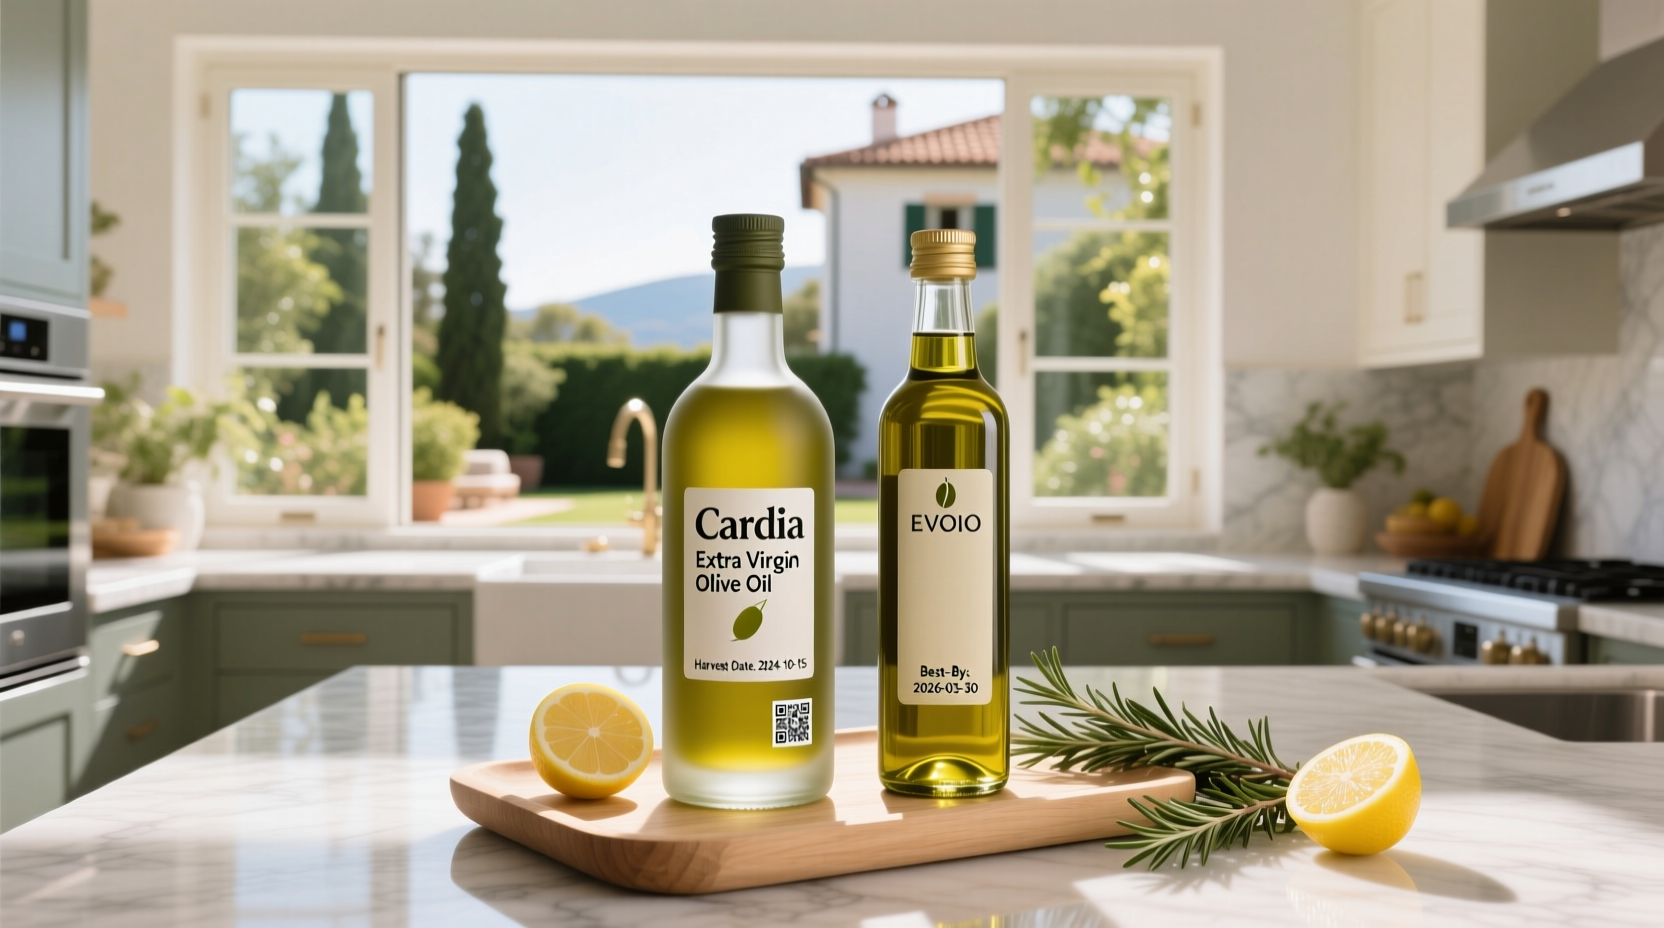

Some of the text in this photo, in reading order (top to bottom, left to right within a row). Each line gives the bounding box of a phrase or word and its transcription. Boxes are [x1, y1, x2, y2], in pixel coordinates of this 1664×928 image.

[695, 506, 805, 540] Cardia
[911, 514, 981, 532] EVOIO
[696, 550, 799, 574] Extra Virgin
[695, 573, 772, 592] Olive Oil
[694, 658, 728, 672] Harvest
